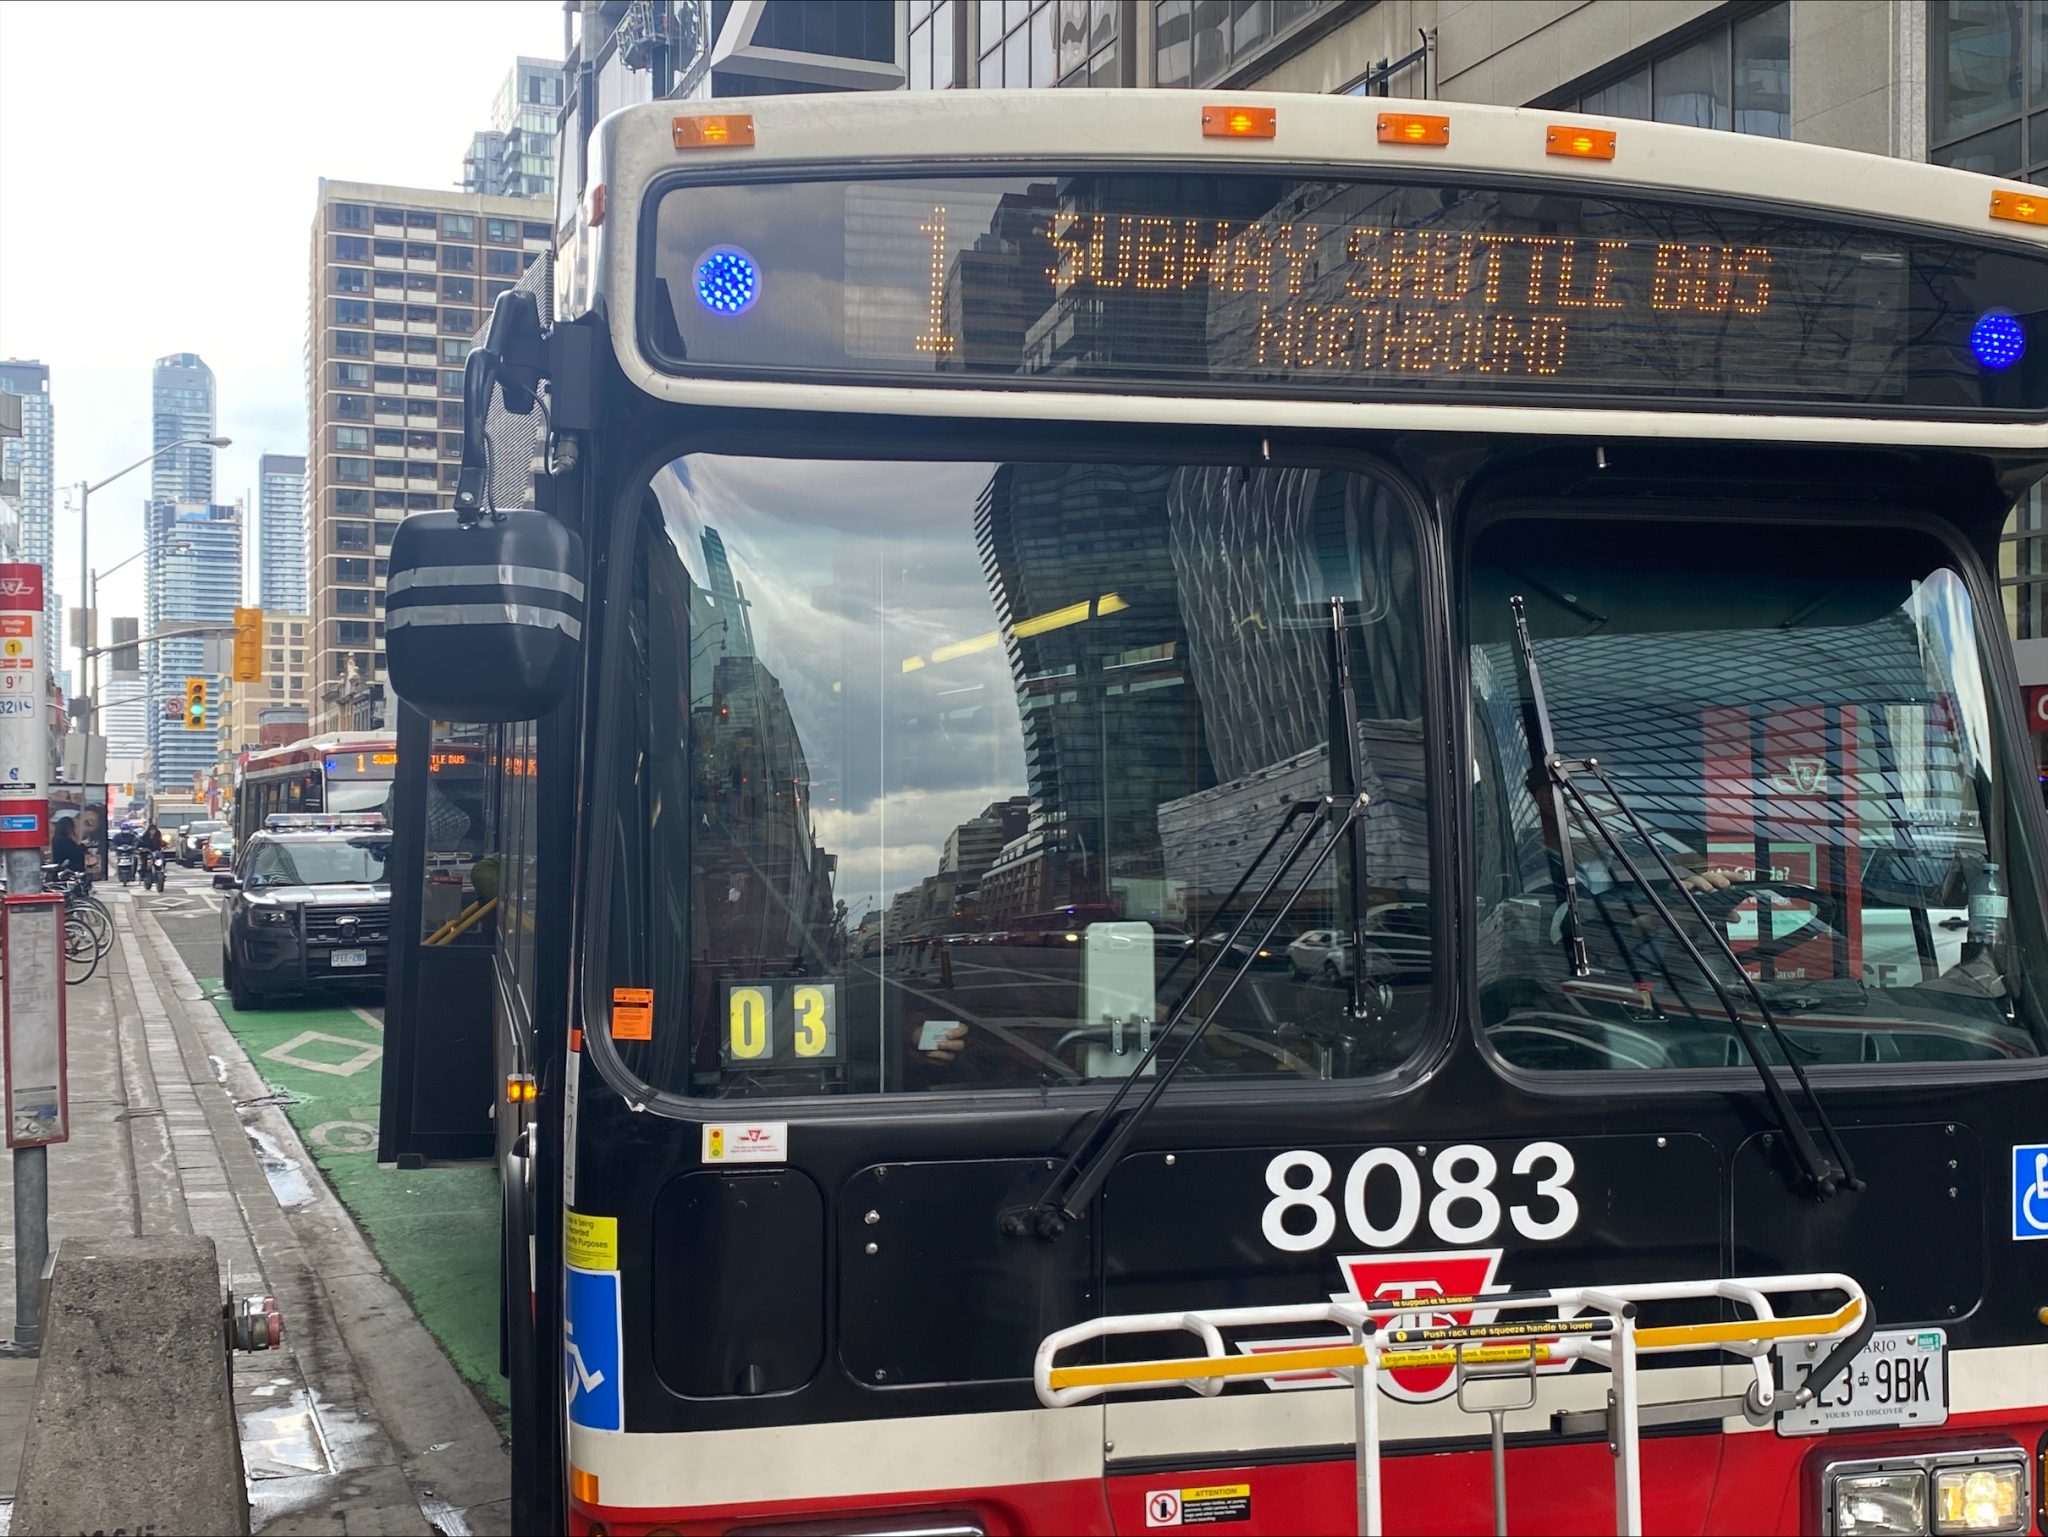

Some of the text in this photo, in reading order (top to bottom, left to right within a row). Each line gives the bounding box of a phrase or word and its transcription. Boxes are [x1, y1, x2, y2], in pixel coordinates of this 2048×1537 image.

[916, 206, 1772, 352] 1 SUBWAY SHUTTLE BUS
[1258, 304, 1567, 374] NORTHBOUND
[357, 754, 366, 773] 1
[431, 754, 447, 764] TLE
[448, 754, 466, 765] BUS
[1261, 1141, 1580, 1252] 8083
[578, 1237, 608, 1248] Purposes
[1401, 1298, 1429, 1307] support
[1423, 1329, 1446, 1339] Push
[1448, 1328, 1467, 1337] rack
[1470, 1327, 1486, 1336] and
[1489, 1325, 1525, 1335] squeeze
[1526, 1323, 1557, 1332] handle
[1570, 1322, 1593, 1330] lower
[1876, 1357, 1930, 1404] 9BK
[1825, 1407, 1903, 1419] YOURS TO DISCOVER
[1195, 1488, 1237, 1497] ATTENTION
